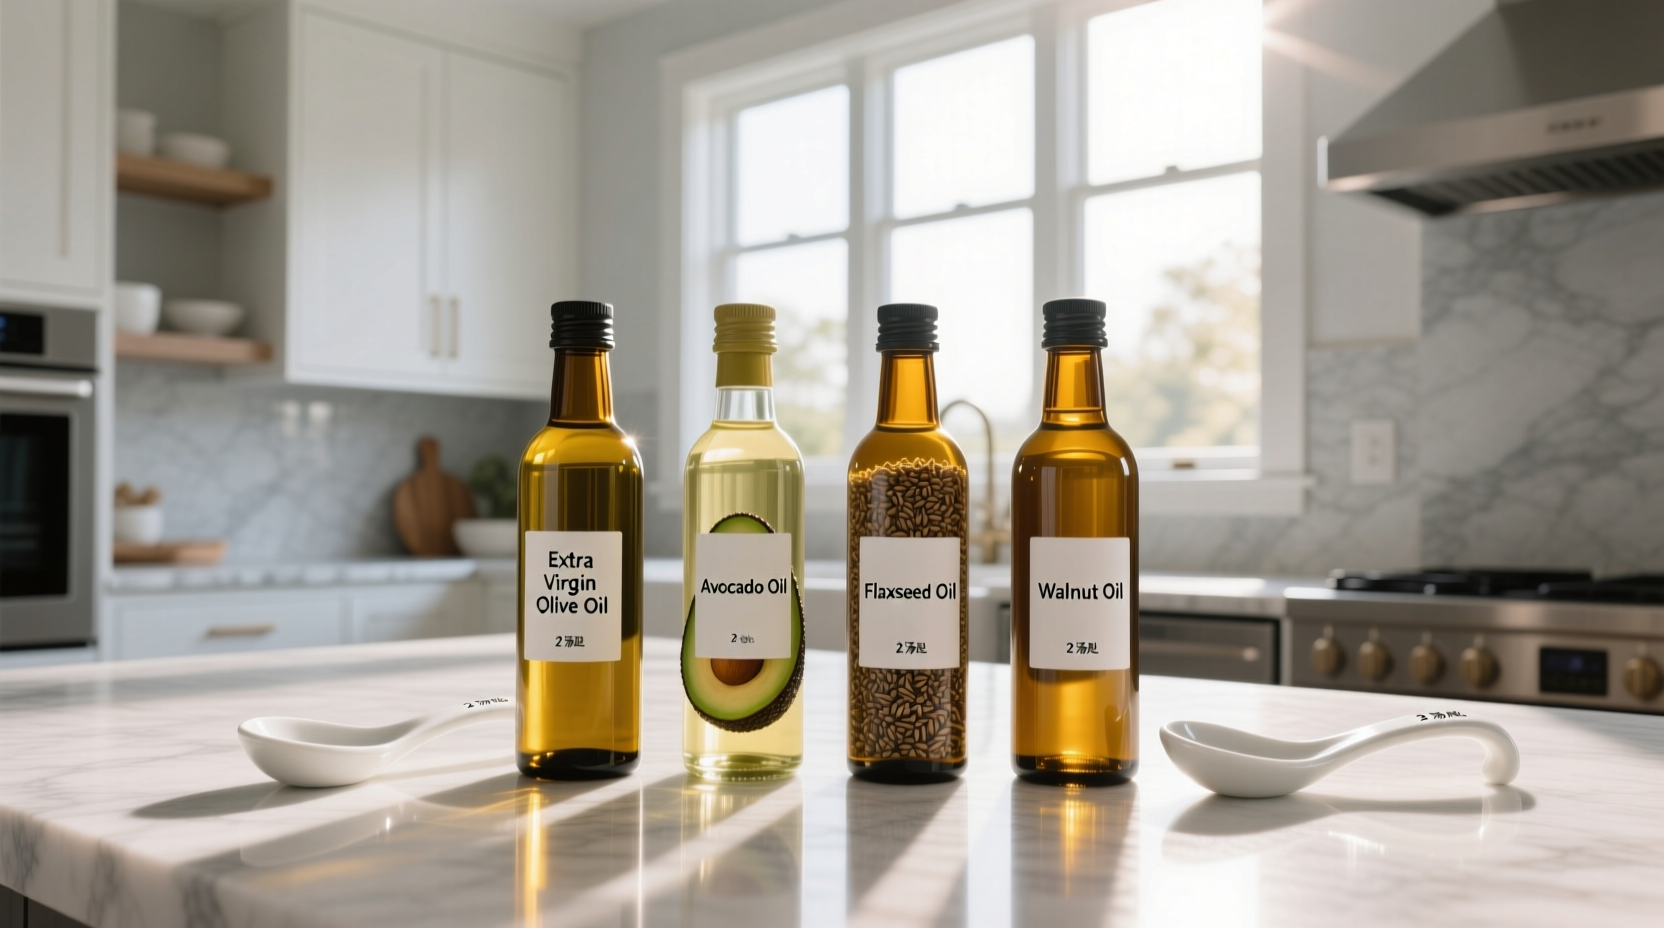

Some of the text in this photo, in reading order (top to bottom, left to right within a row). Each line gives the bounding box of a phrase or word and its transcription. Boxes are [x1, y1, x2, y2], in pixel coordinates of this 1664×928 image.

[549, 550, 594, 569] Extra
[543, 574, 597, 597] Virgin
[700, 577, 788, 595] Avocado Oil
[864, 582, 957, 600] Flaxseed Oil
[1037, 582, 1124, 600] Walnut Oil
[536, 595, 608, 615] Olive Oil
